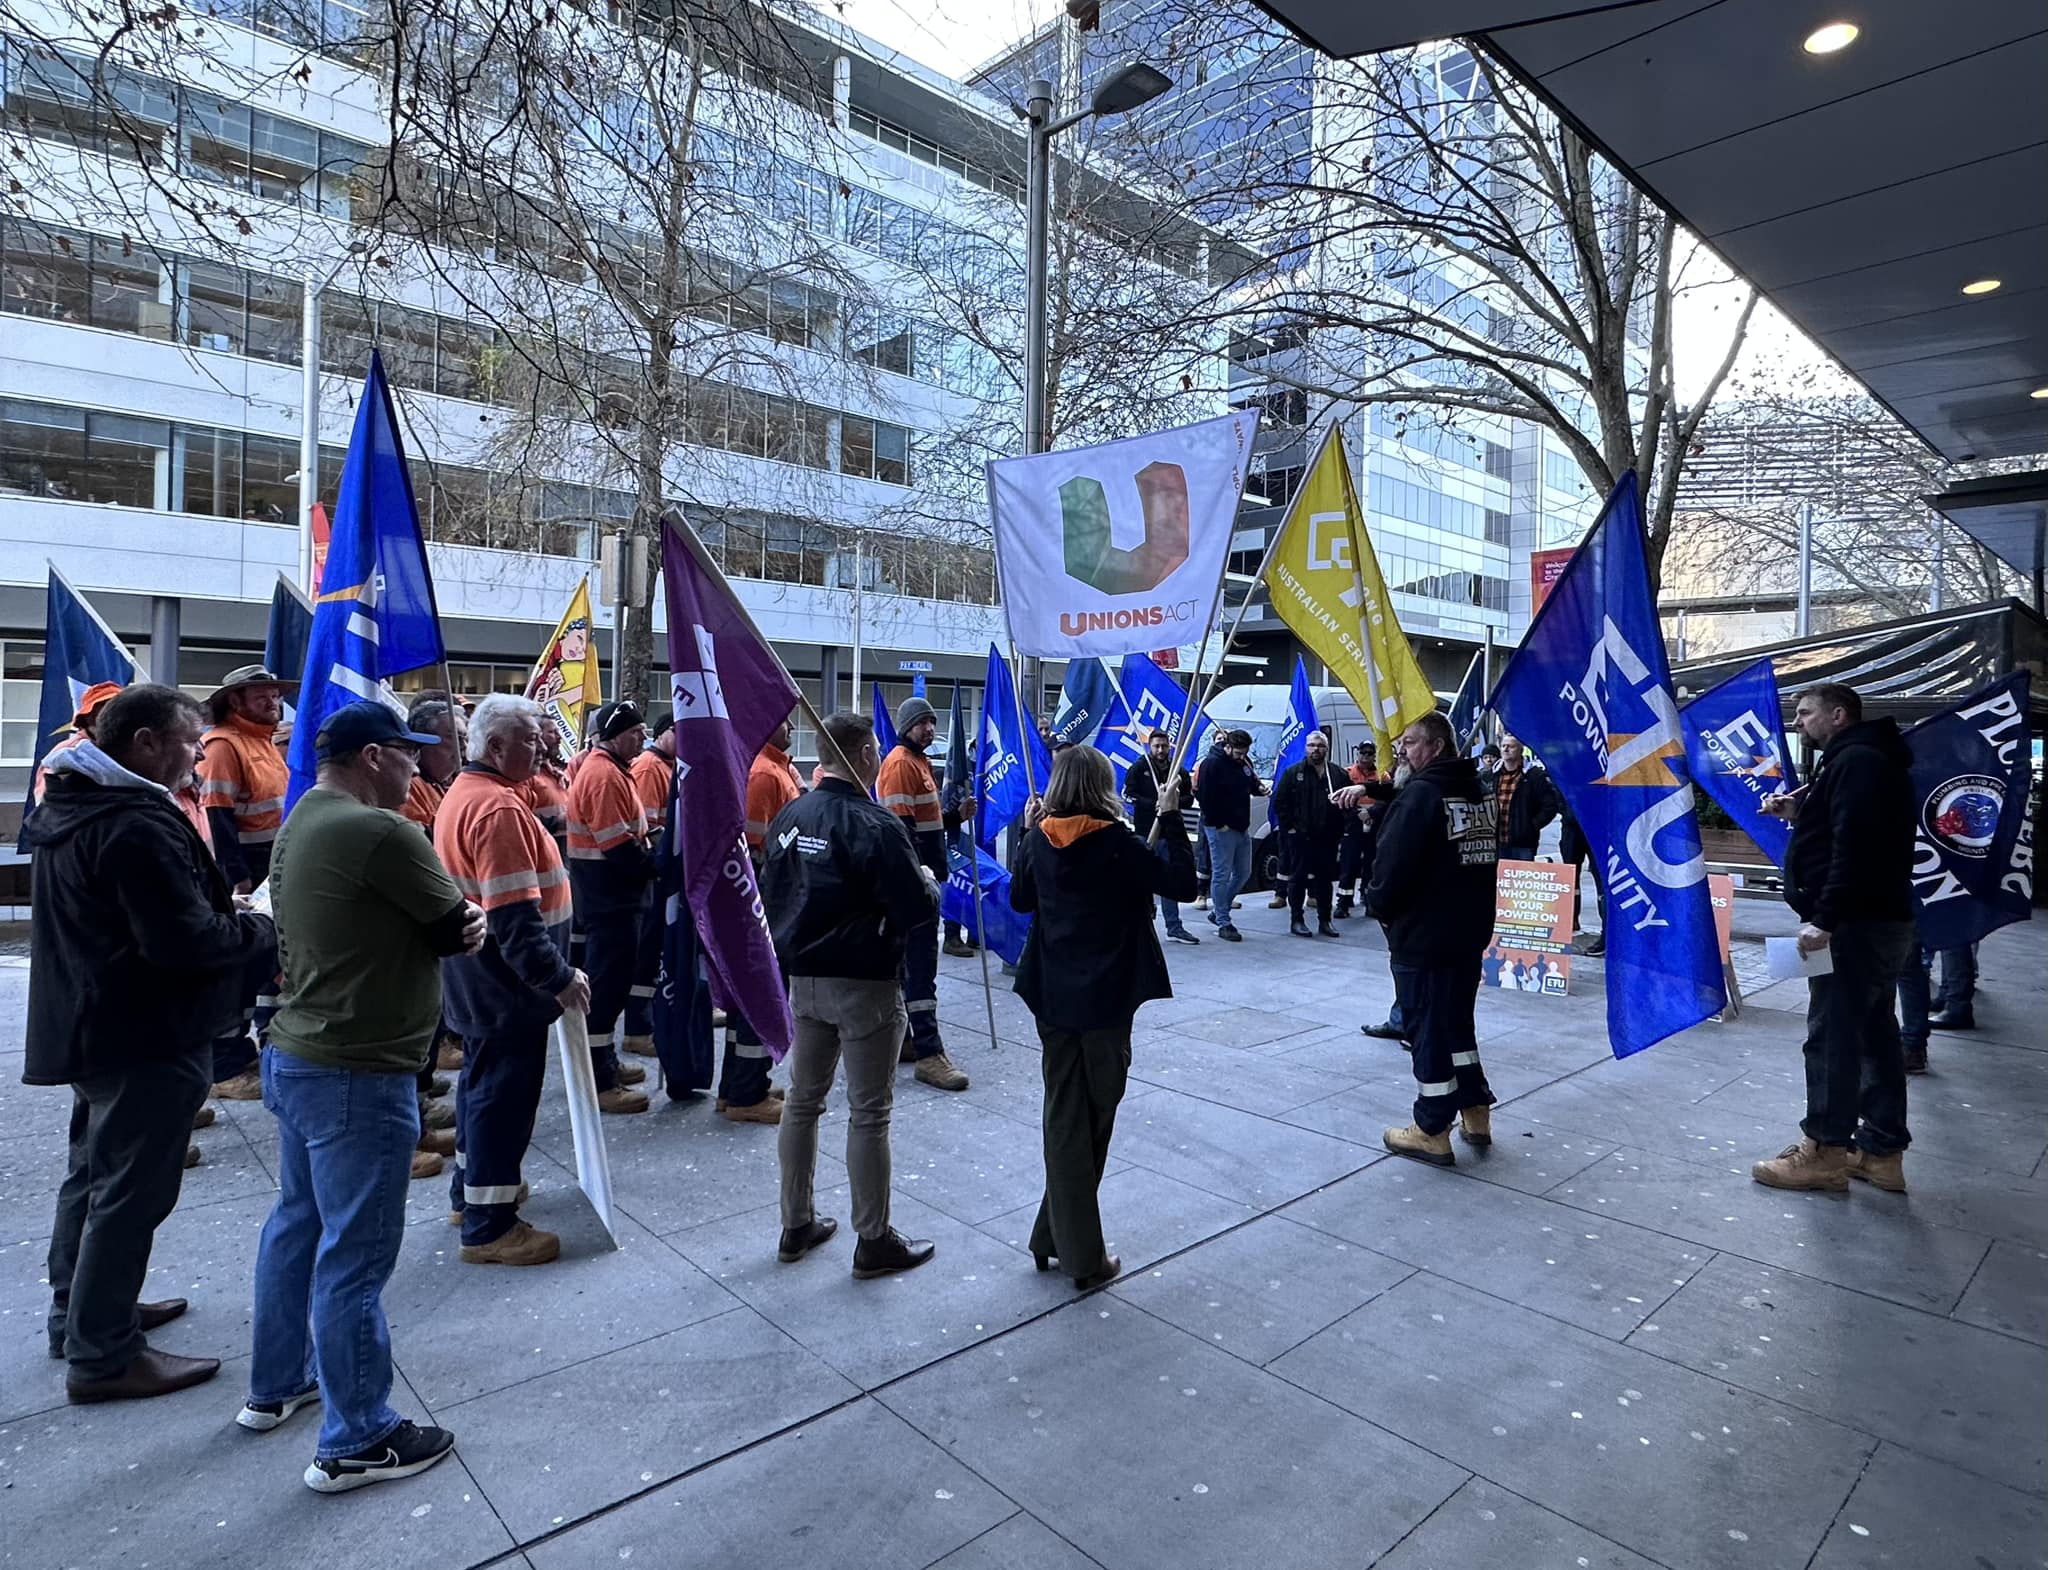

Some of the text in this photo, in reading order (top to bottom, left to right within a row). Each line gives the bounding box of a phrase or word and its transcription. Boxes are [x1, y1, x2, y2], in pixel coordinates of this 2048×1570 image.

[1277, 563, 1339, 633] AUSTRALIAN
[1060, 599, 1200, 637] UNIONSACT
[548, 704, 571, 739] STRONG
[1700, 729, 1762, 792] POWER IN
[1715, 709, 1787, 796] ET
[1931, 779, 1968, 804] PLUMBING
[1558, 681, 1669, 931] POWE NITY
[1496, 878, 1570, 893] HE WORKERS
[1503, 869, 1556, 881] SUPPORT
[1499, 888, 1559, 902] WHO KEEP
[1512, 900, 1544, 911] YOUR
[1496, 909, 1558, 922] POWER ON
[1547, 977, 1565, 988] ETU
